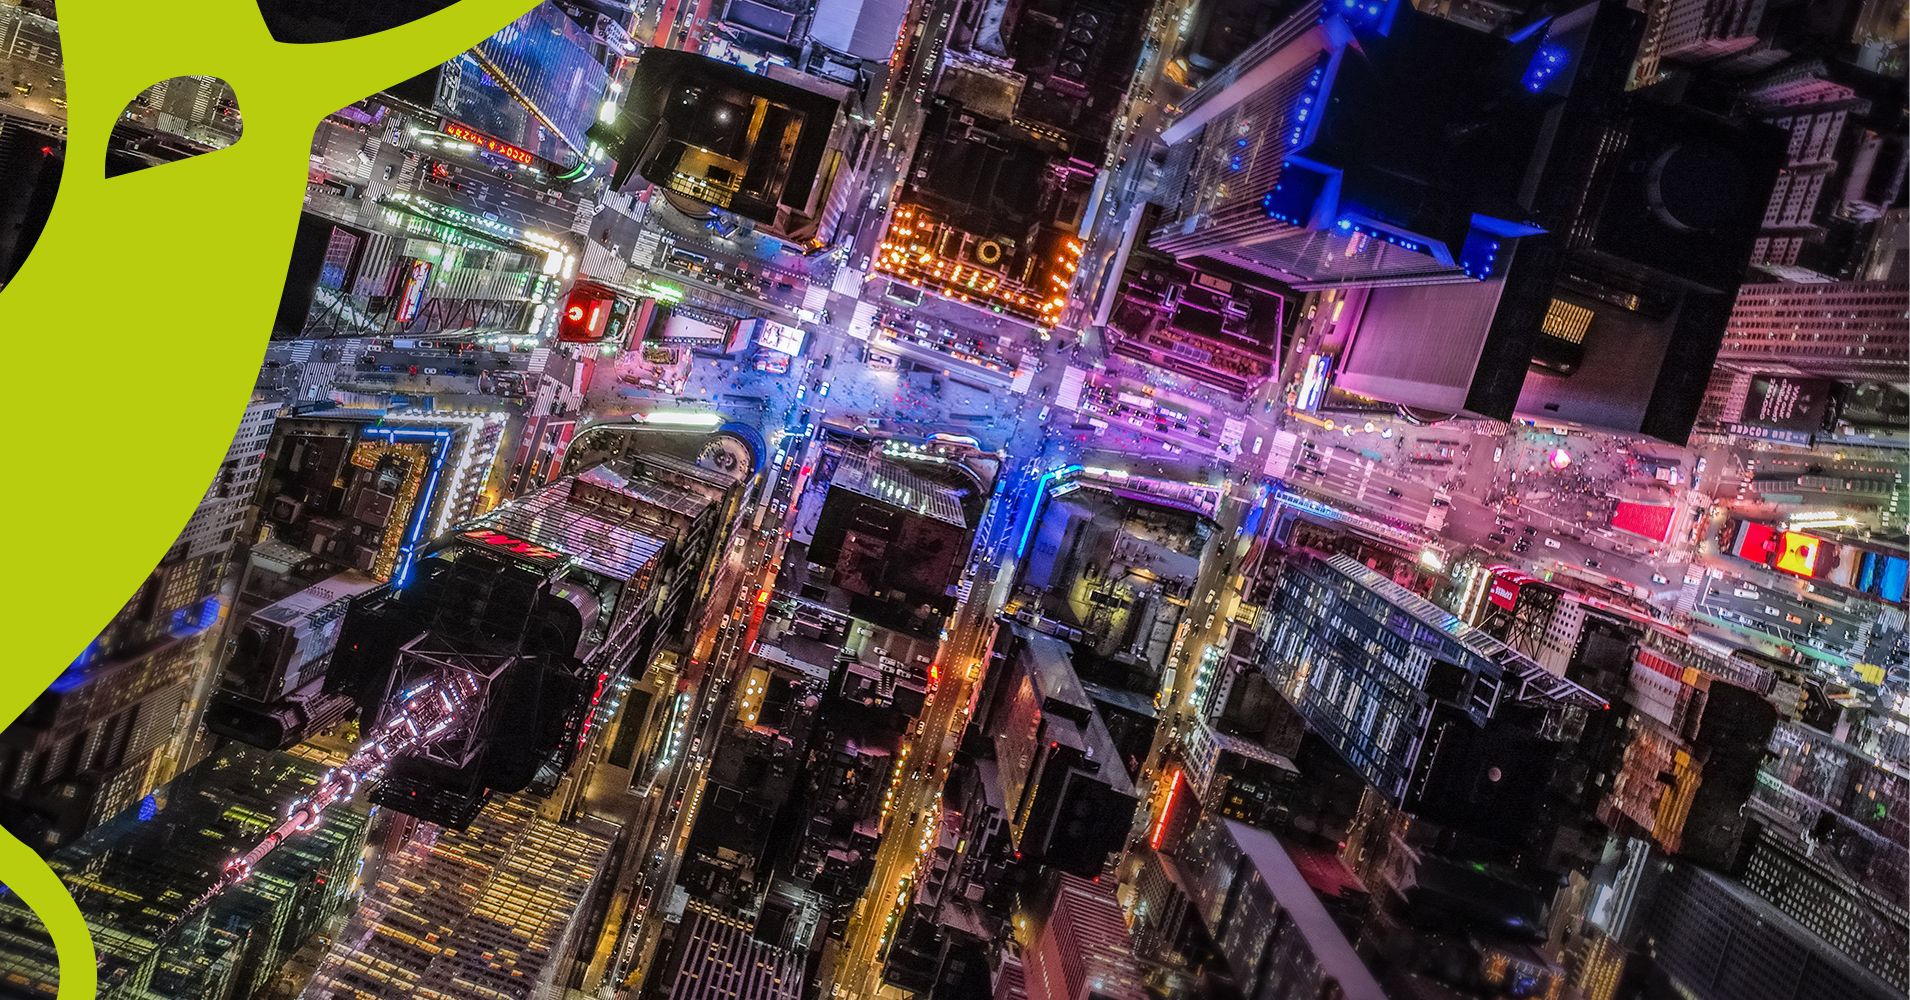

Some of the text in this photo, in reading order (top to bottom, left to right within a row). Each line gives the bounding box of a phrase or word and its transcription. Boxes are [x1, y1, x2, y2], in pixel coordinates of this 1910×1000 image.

[447, 125, 531, 164] ERNST & YOUNG
